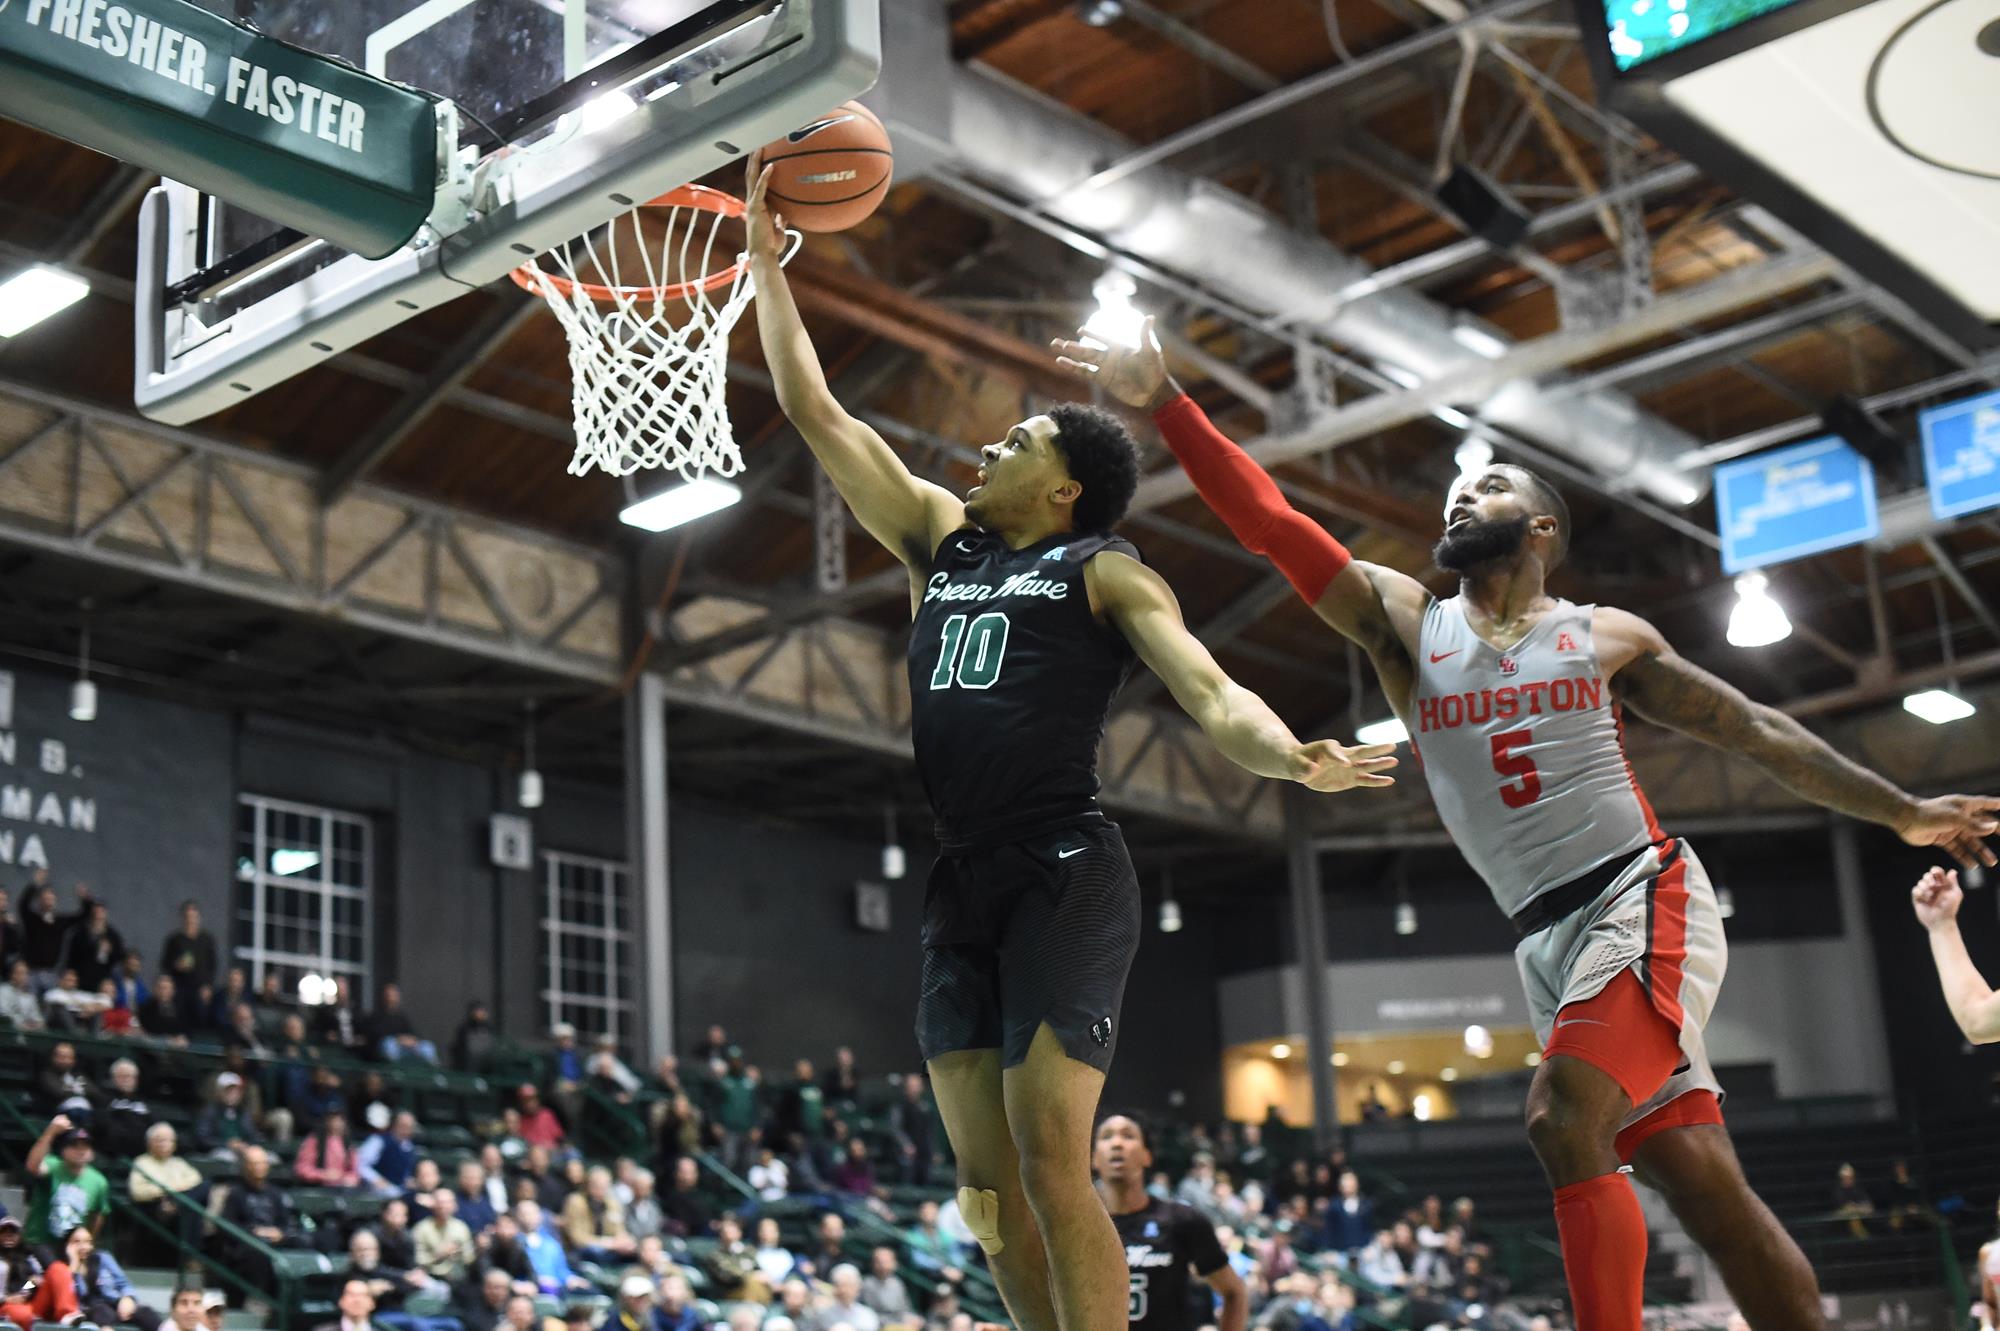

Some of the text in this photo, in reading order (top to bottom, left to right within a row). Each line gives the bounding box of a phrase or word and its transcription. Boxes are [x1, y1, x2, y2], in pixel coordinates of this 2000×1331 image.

[225, 56, 366, 153] FASTER
[924, 570, 1068, 603] Green Wave
[930, 612, 1010, 690] 10
[1418, 677, 1601, 733] HOUSTON
[1491, 729, 1541, 809] 5
